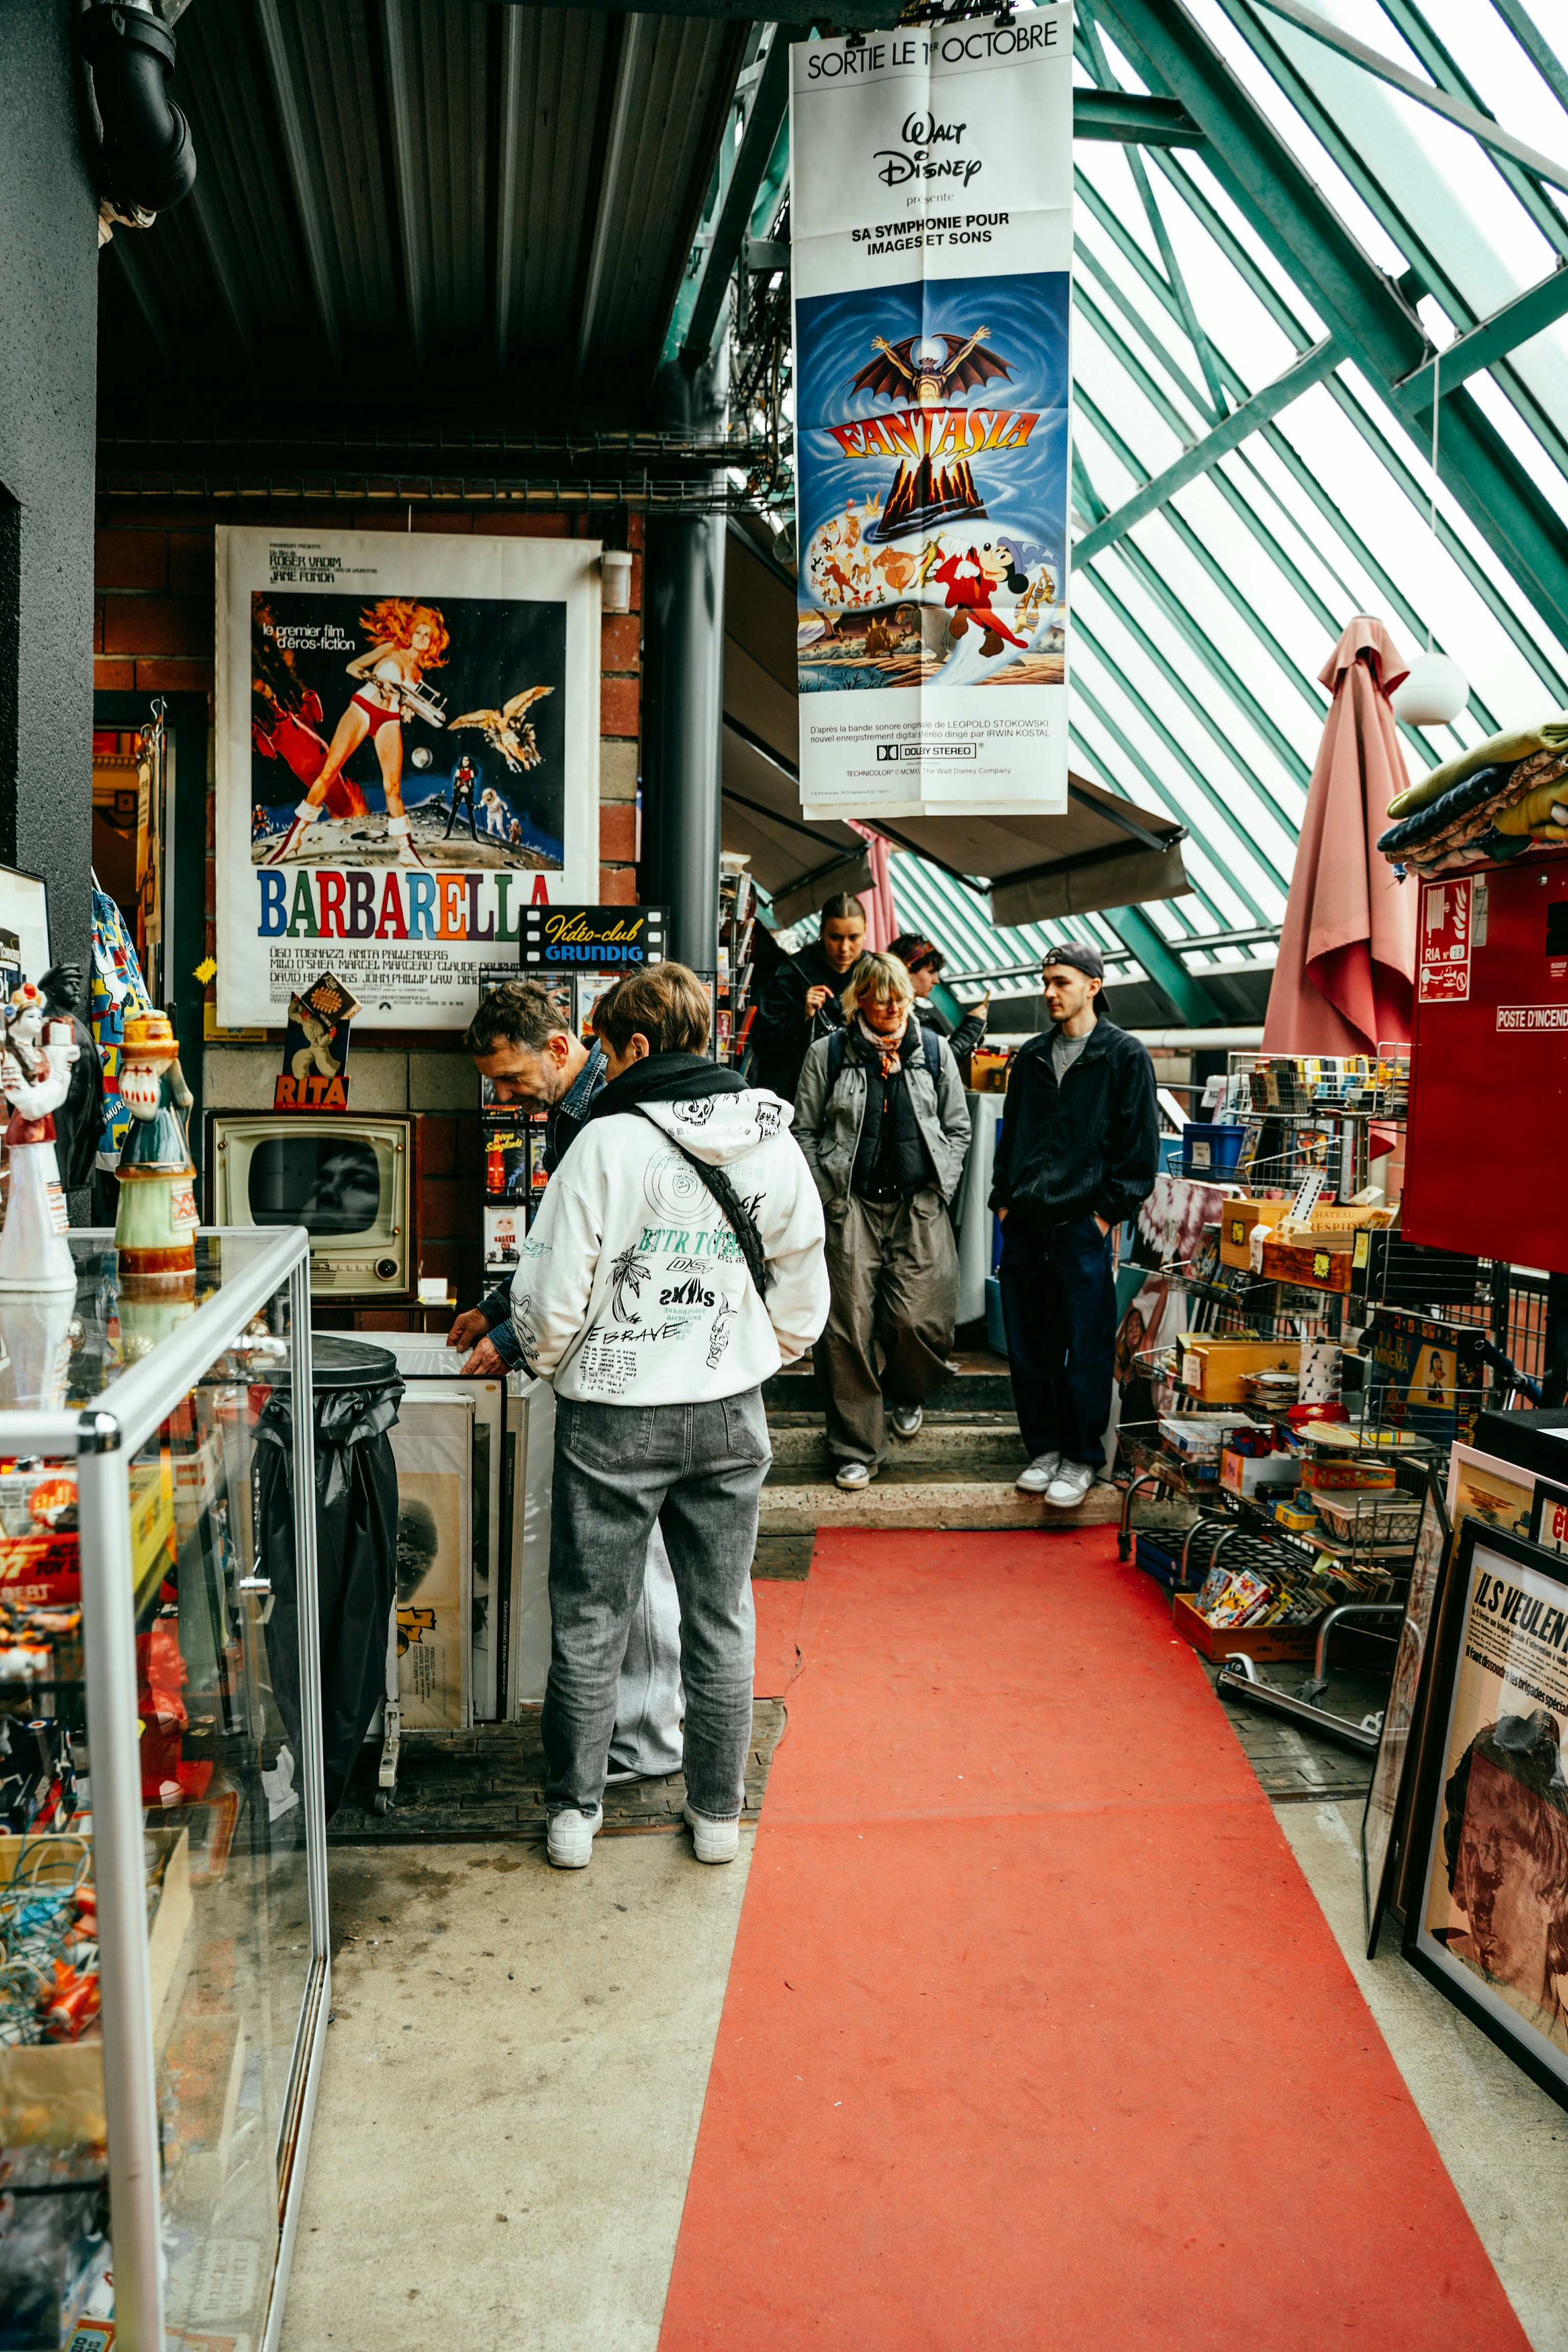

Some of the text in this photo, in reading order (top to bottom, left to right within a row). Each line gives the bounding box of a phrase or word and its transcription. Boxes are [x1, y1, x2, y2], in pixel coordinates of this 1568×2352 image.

[807, 44, 885, 79] SORTIE
[892, 41, 916, 65] LE
[942, 21, 1058, 62] OCTOBRE
[906, 192, 954, 207] présente
[852, 213, 1009, 242] SA SYMPHONIE POUR
[868, 231, 992, 256] IMAGES ET SONS
[823, 406, 1040, 468] FANTASIA
[270, 557, 341, 568] ROGER VADIM
[270, 571, 335, 583] JANE FONDA
[263, 623, 345, 638] le premier film
[811, 725, 838, 734] D'après
[849, 724, 873, 732] bande
[903, 721, 932, 730] originale
[948, 720, 991, 728] LEOPOLD
[993, 720, 1049, 728] STOKOWSKI
[811, 735, 834, 743] nouvel
[836, 733, 894, 743] enregistrement
[896, 731, 917, 741] digital
[918, 729, 942, 738] stéréo
[945, 730, 968, 739] dirigé
[971, 731, 984, 739] par
[904, 747, 971, 756] DOLBY STEREO
[546, 912, 644, 943] Vidéo-club
[270, 948, 448, 960] UGO TOGNAZZI ANITA PALLENBERG
[546, 945, 643, 961] GRUNDIG
[1425, 948, 1440, 962] RIA
[1453, 948, 1462, 958] 28
[271, 959, 477, 971] MILO O'SHEA MARCEL MARCEAU CLAUDE
[270, 972, 301, 982] DAVID
[304, 973, 357, 983] HENGS
[363, 973, 389, 983] JOHN
[393, 974, 427, 984] PHILLIP
[430, 975, 452, 984] LAW
[1499, 1010, 1526, 1027] POSTE
[276, 1077, 347, 1105] RITA
[718, 1252, 732, 1264] KISS
[603, 1321, 688, 1344] BRAVE
[1457, 1392, 1471, 1444] ROJECTEUR
[1474, 1572, 1504, 1612] ILS
[1497, 1620, 1510, 1635] brigade
[1510, 1630, 1525, 1644] spéciale
[1470, 1647, 1482, 1664] faut
[1482, 1655, 1509, 1681] dissoudre
[1509, 1671, 1518, 1686] les
[1518, 1677, 1545, 1703] brigades
[1545, 1695, 1568, 1718] spécial
